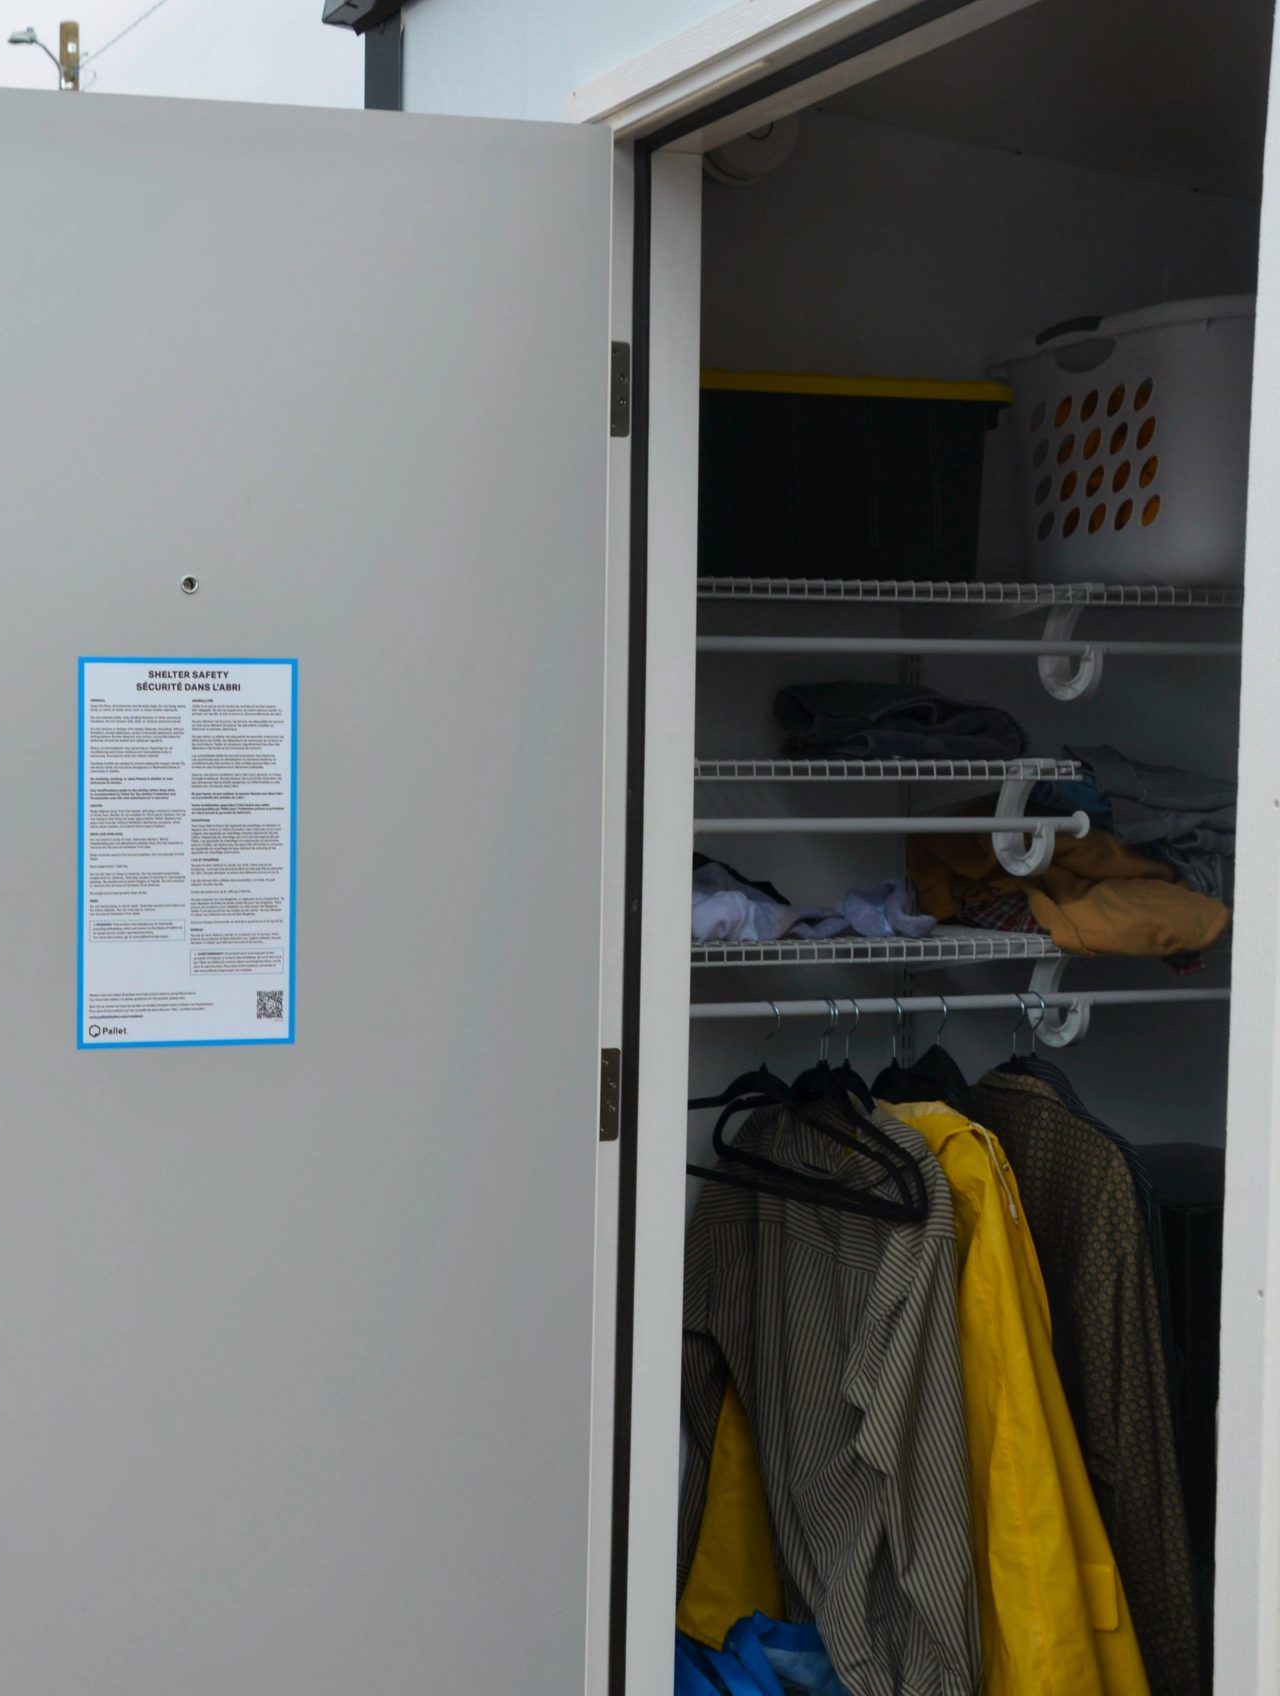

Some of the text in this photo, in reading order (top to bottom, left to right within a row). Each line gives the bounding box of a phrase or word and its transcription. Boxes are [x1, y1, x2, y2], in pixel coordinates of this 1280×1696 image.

[148, 670, 229, 679] SHELTER SAFETY
[136, 681, 241, 692] SÉCURITÉ DANS L'ABRI
[102, 1027, 127, 1035] Pallet
